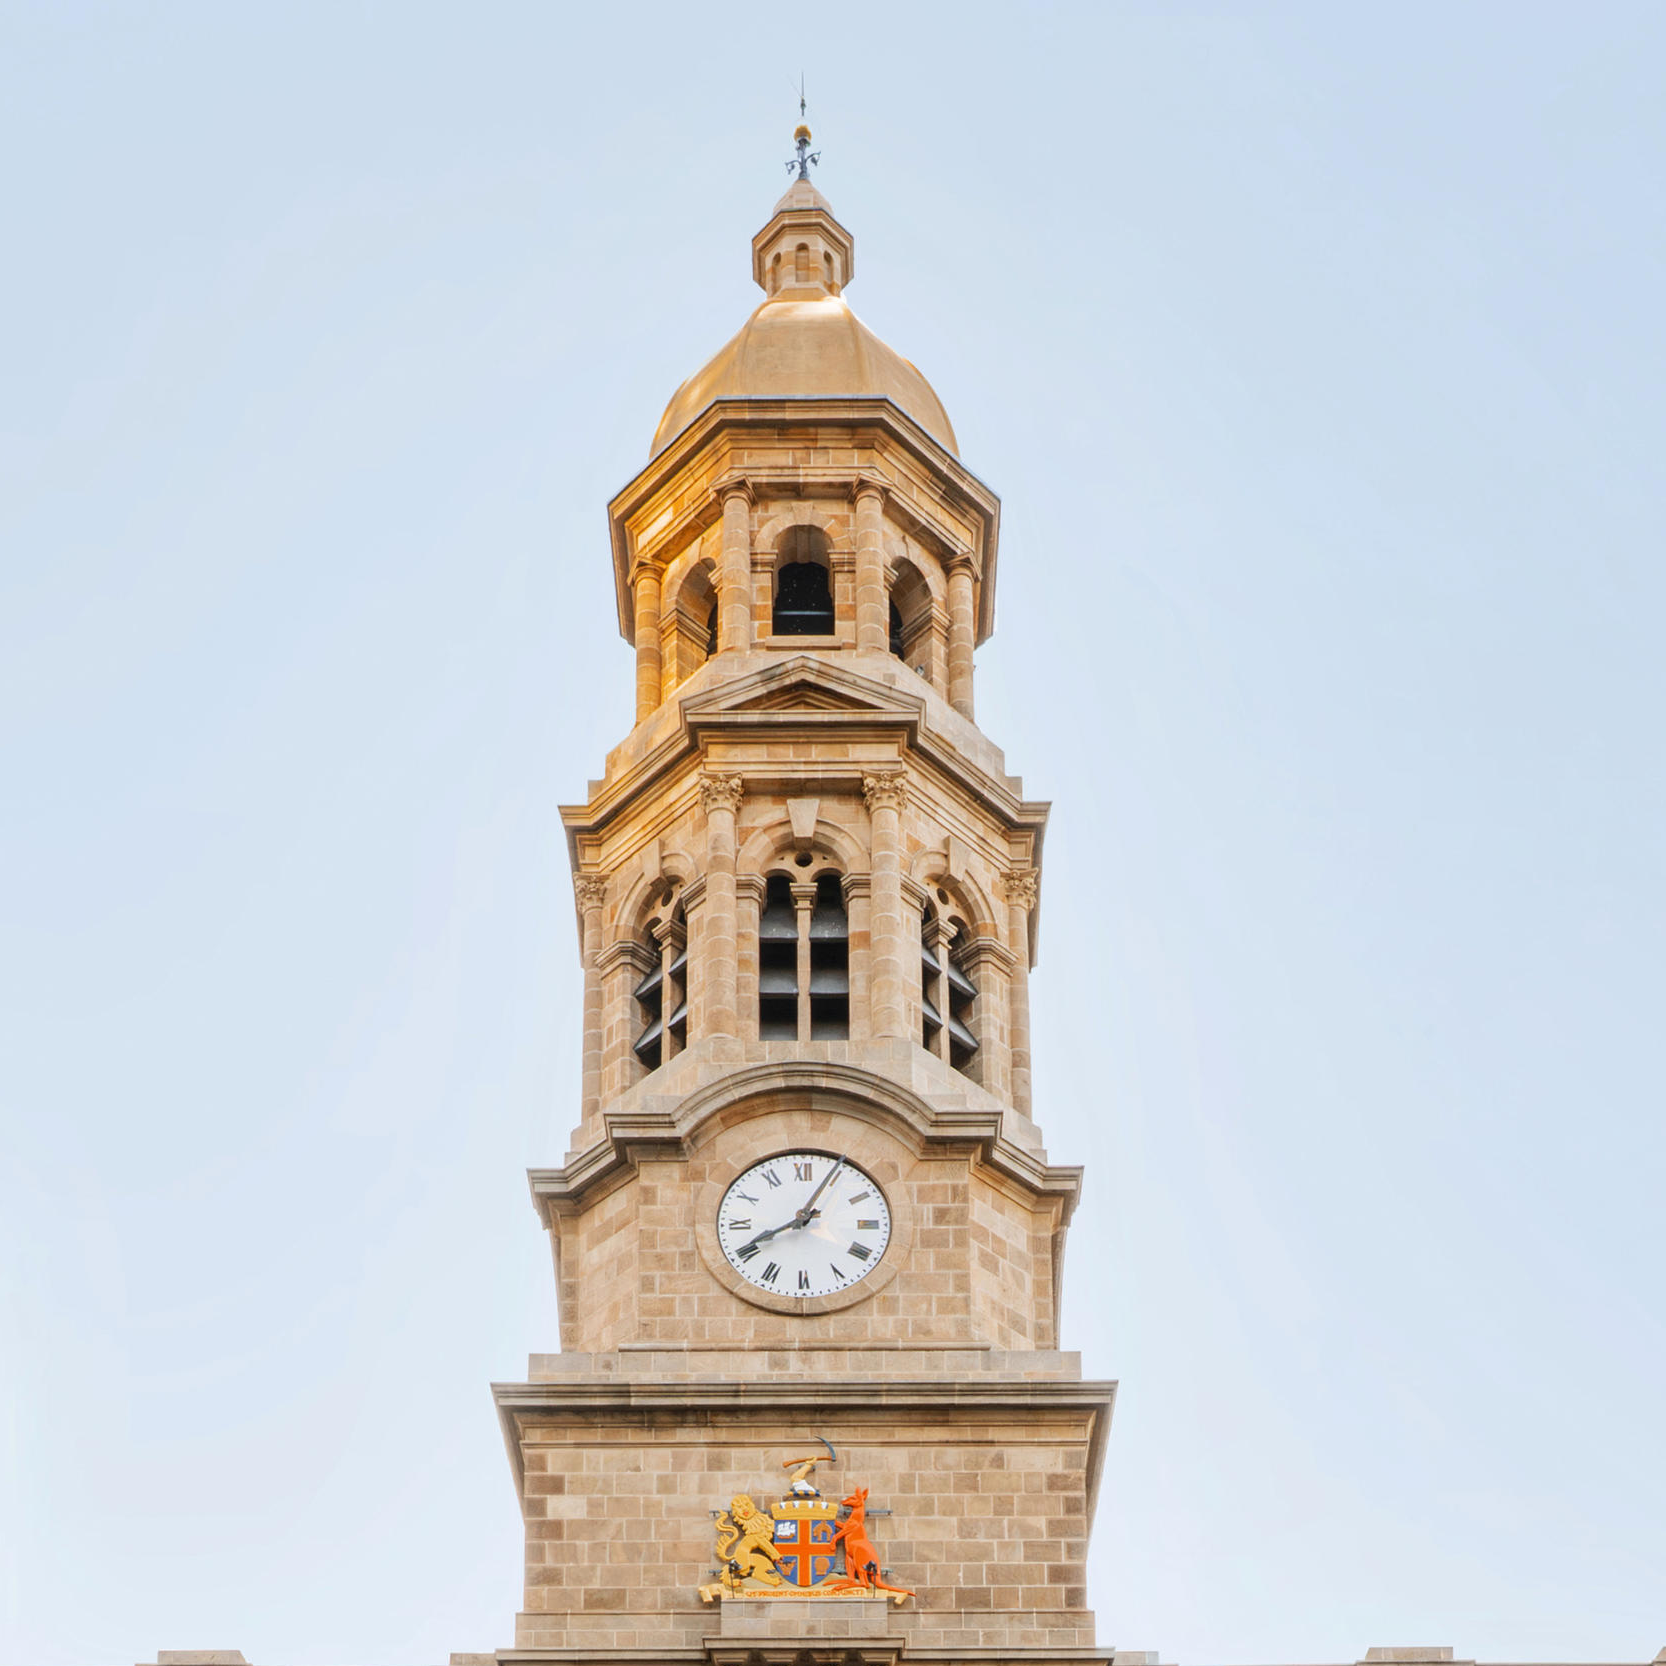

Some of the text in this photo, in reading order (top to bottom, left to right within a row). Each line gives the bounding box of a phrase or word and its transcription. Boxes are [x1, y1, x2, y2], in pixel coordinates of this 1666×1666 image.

[761, 1169, 782, 1190] XI
[793, 1163, 812, 1181] XII
[736, 1191, 759, 1206] X
[729, 1218, 751, 1230] IX
[761, 1262, 782, 1284] VII
[798, 1270, 810, 1290] VI
[830, 1263, 846, 1282] V
